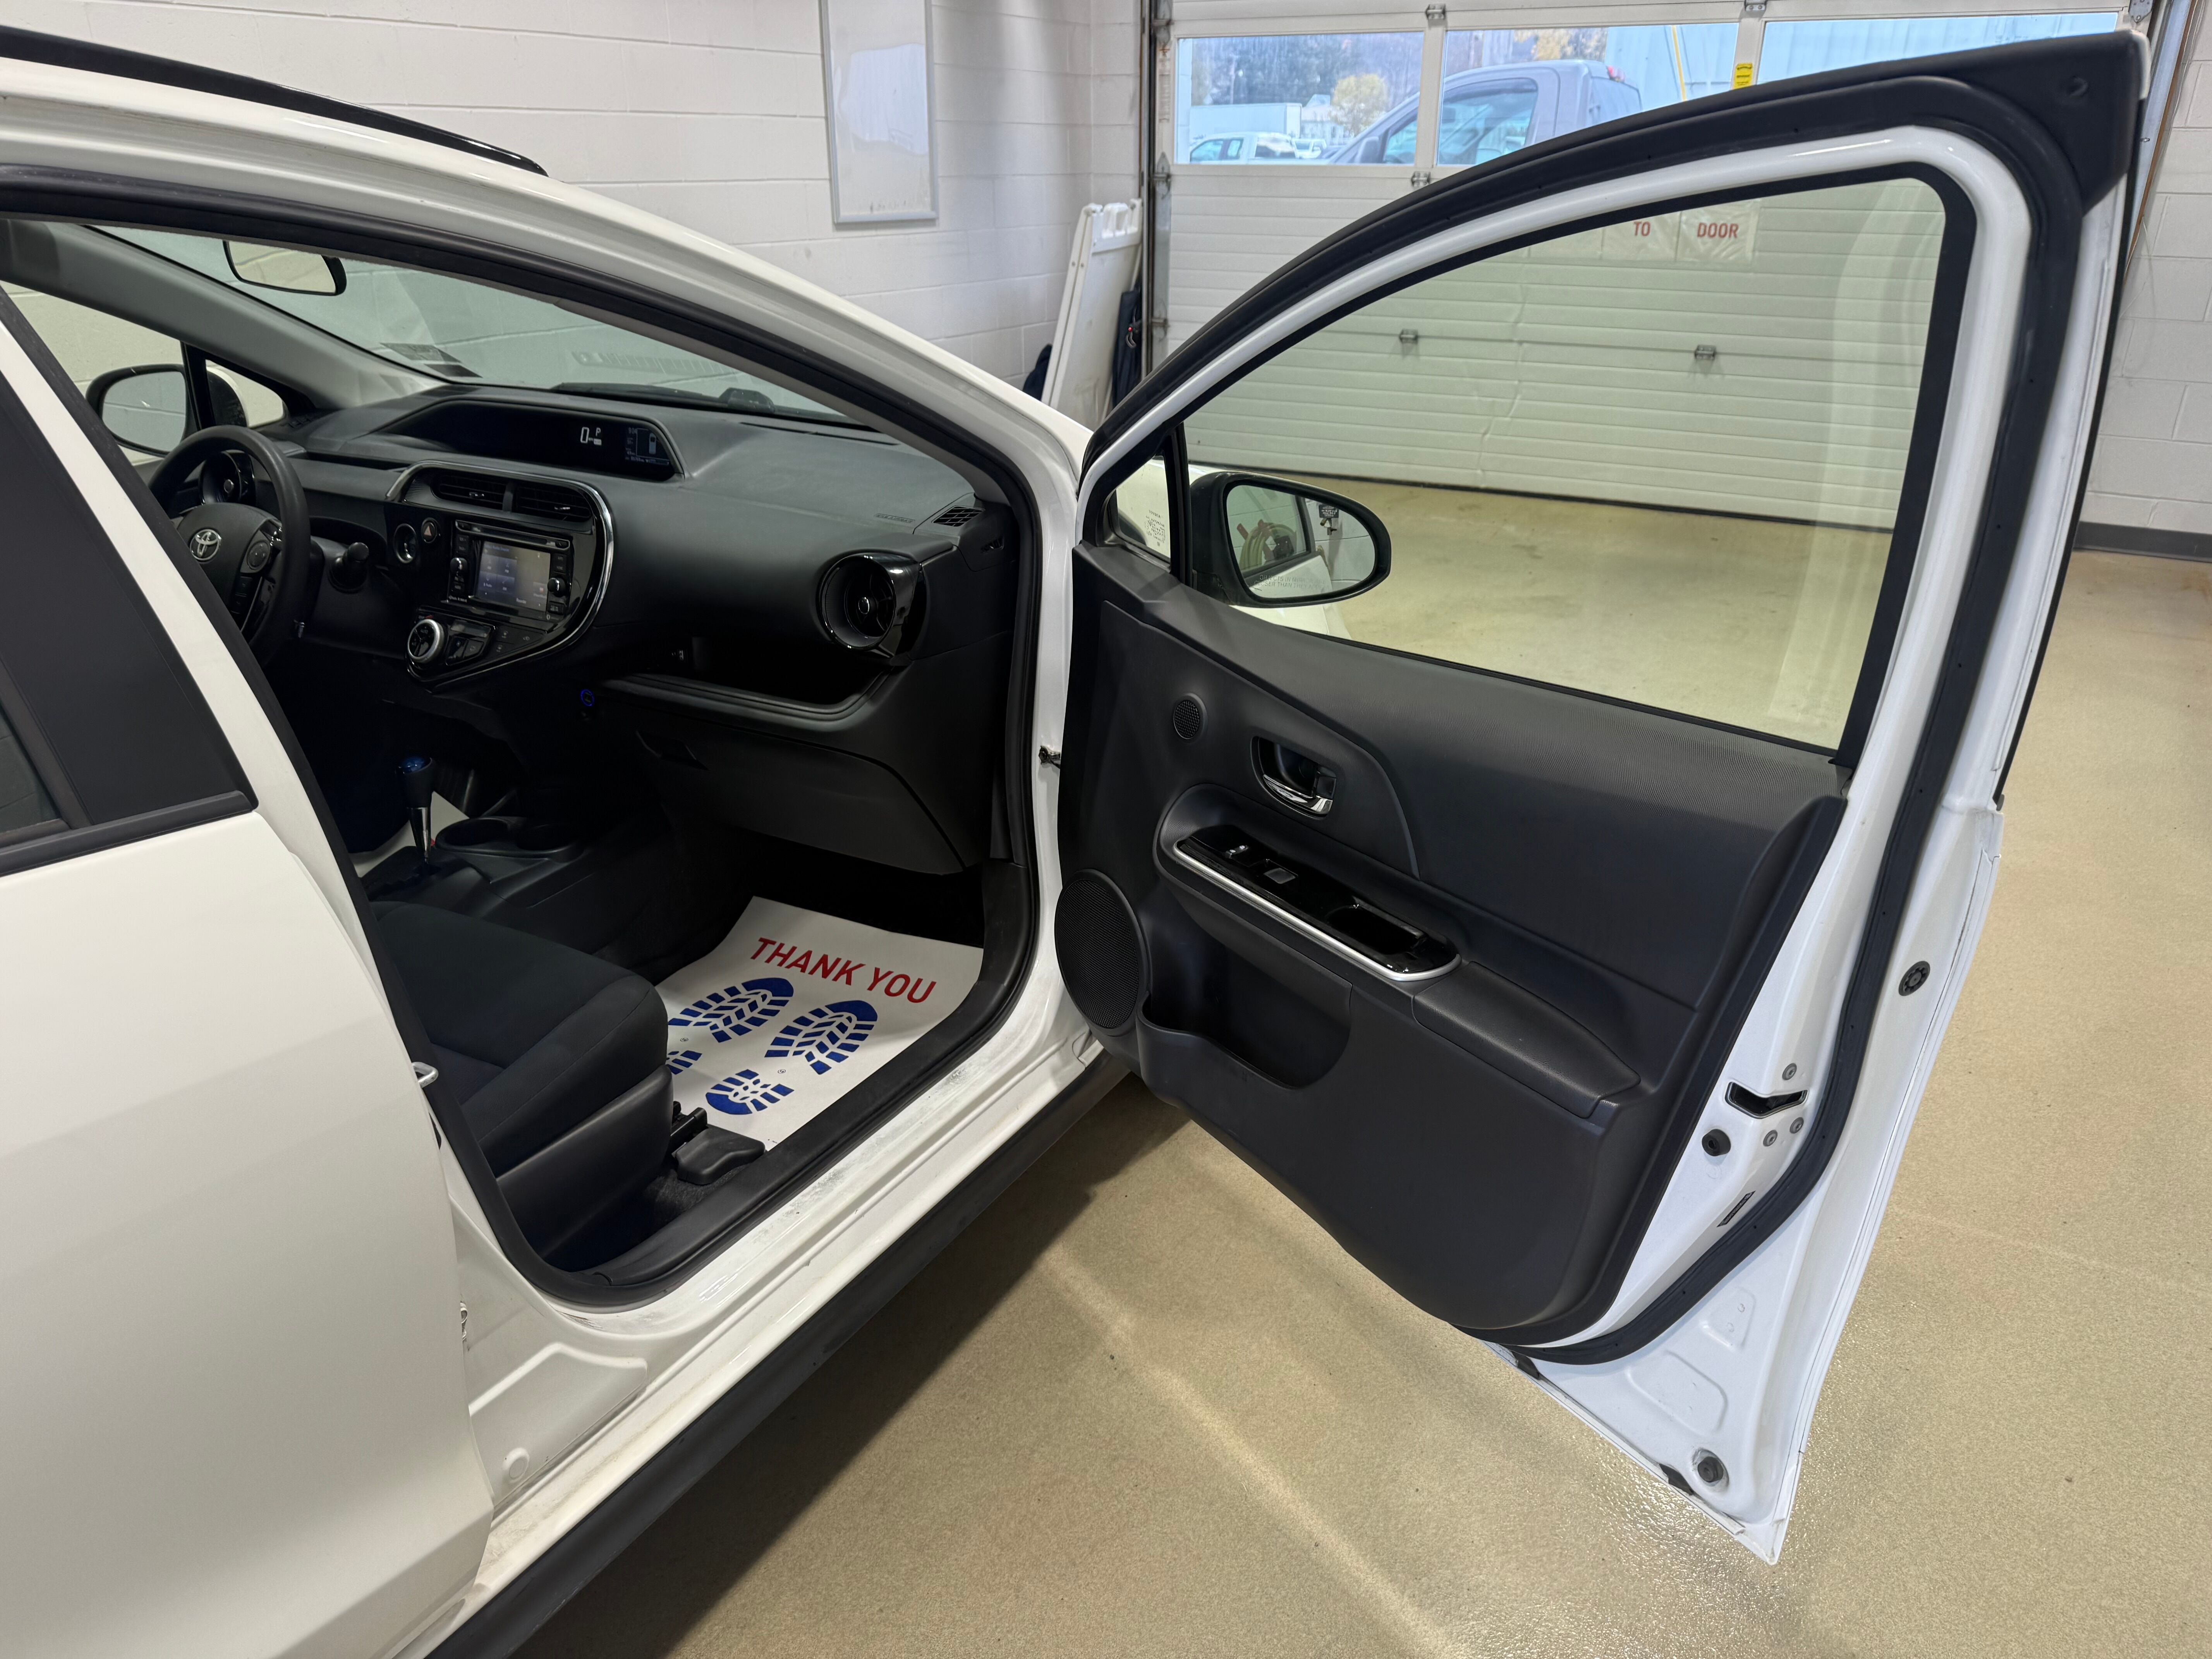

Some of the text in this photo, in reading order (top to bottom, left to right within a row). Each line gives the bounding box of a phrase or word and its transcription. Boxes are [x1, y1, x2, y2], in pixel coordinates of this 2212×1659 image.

[1634, 221, 1739, 238] TO DOOR
[596, 427, 601, 436] P
[750, 937, 937, 1003] THANK YOU
